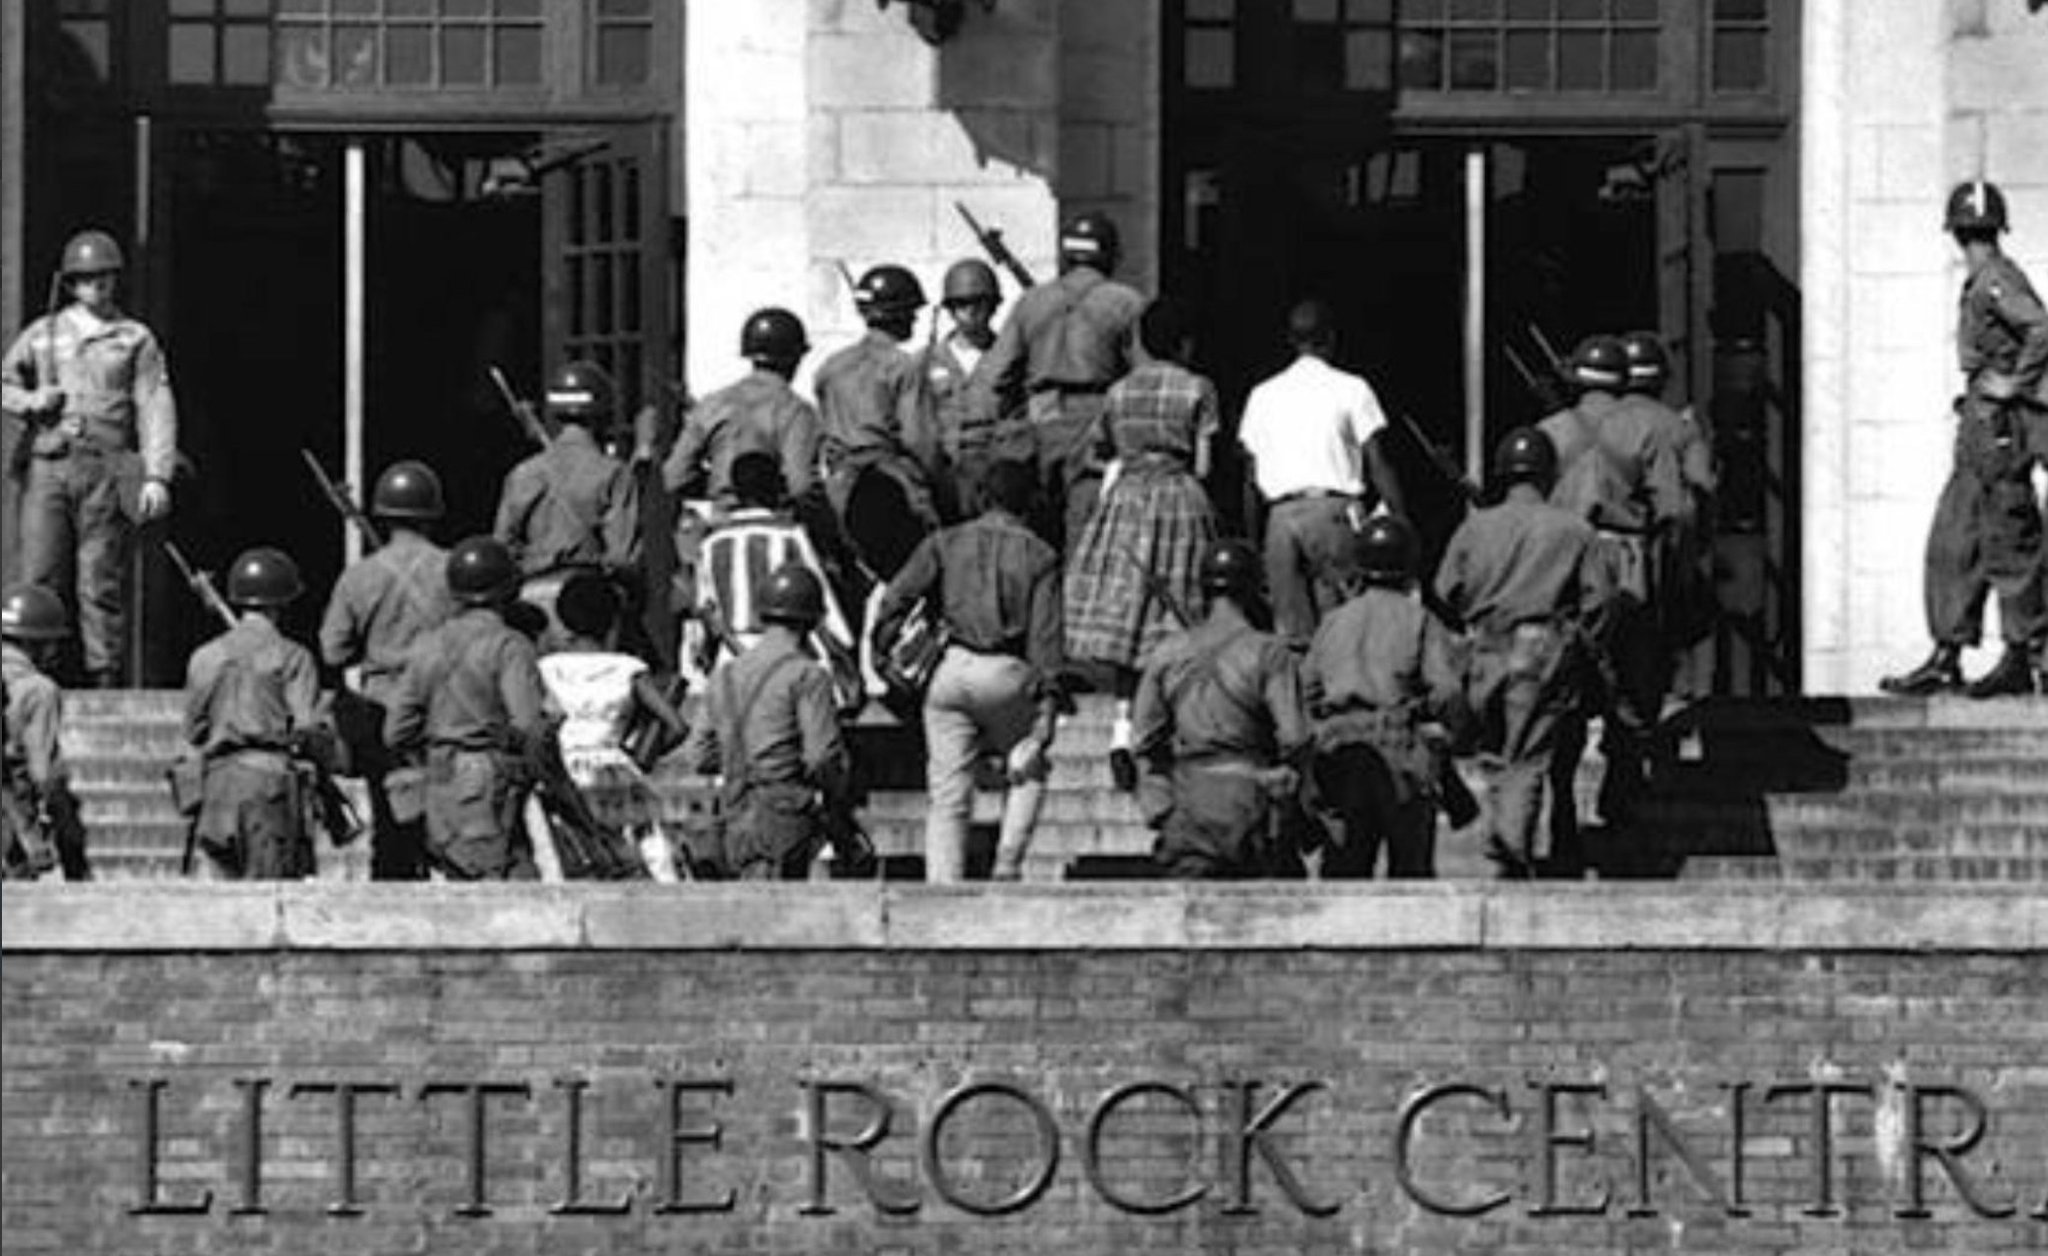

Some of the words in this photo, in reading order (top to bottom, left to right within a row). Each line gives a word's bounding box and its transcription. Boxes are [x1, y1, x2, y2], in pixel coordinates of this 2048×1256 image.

[127, 1078, 736, 1218] LITTLE
[798, 1081, 1342, 1218] ROCK
[1398, 1080, 2048, 1219] CENTR
